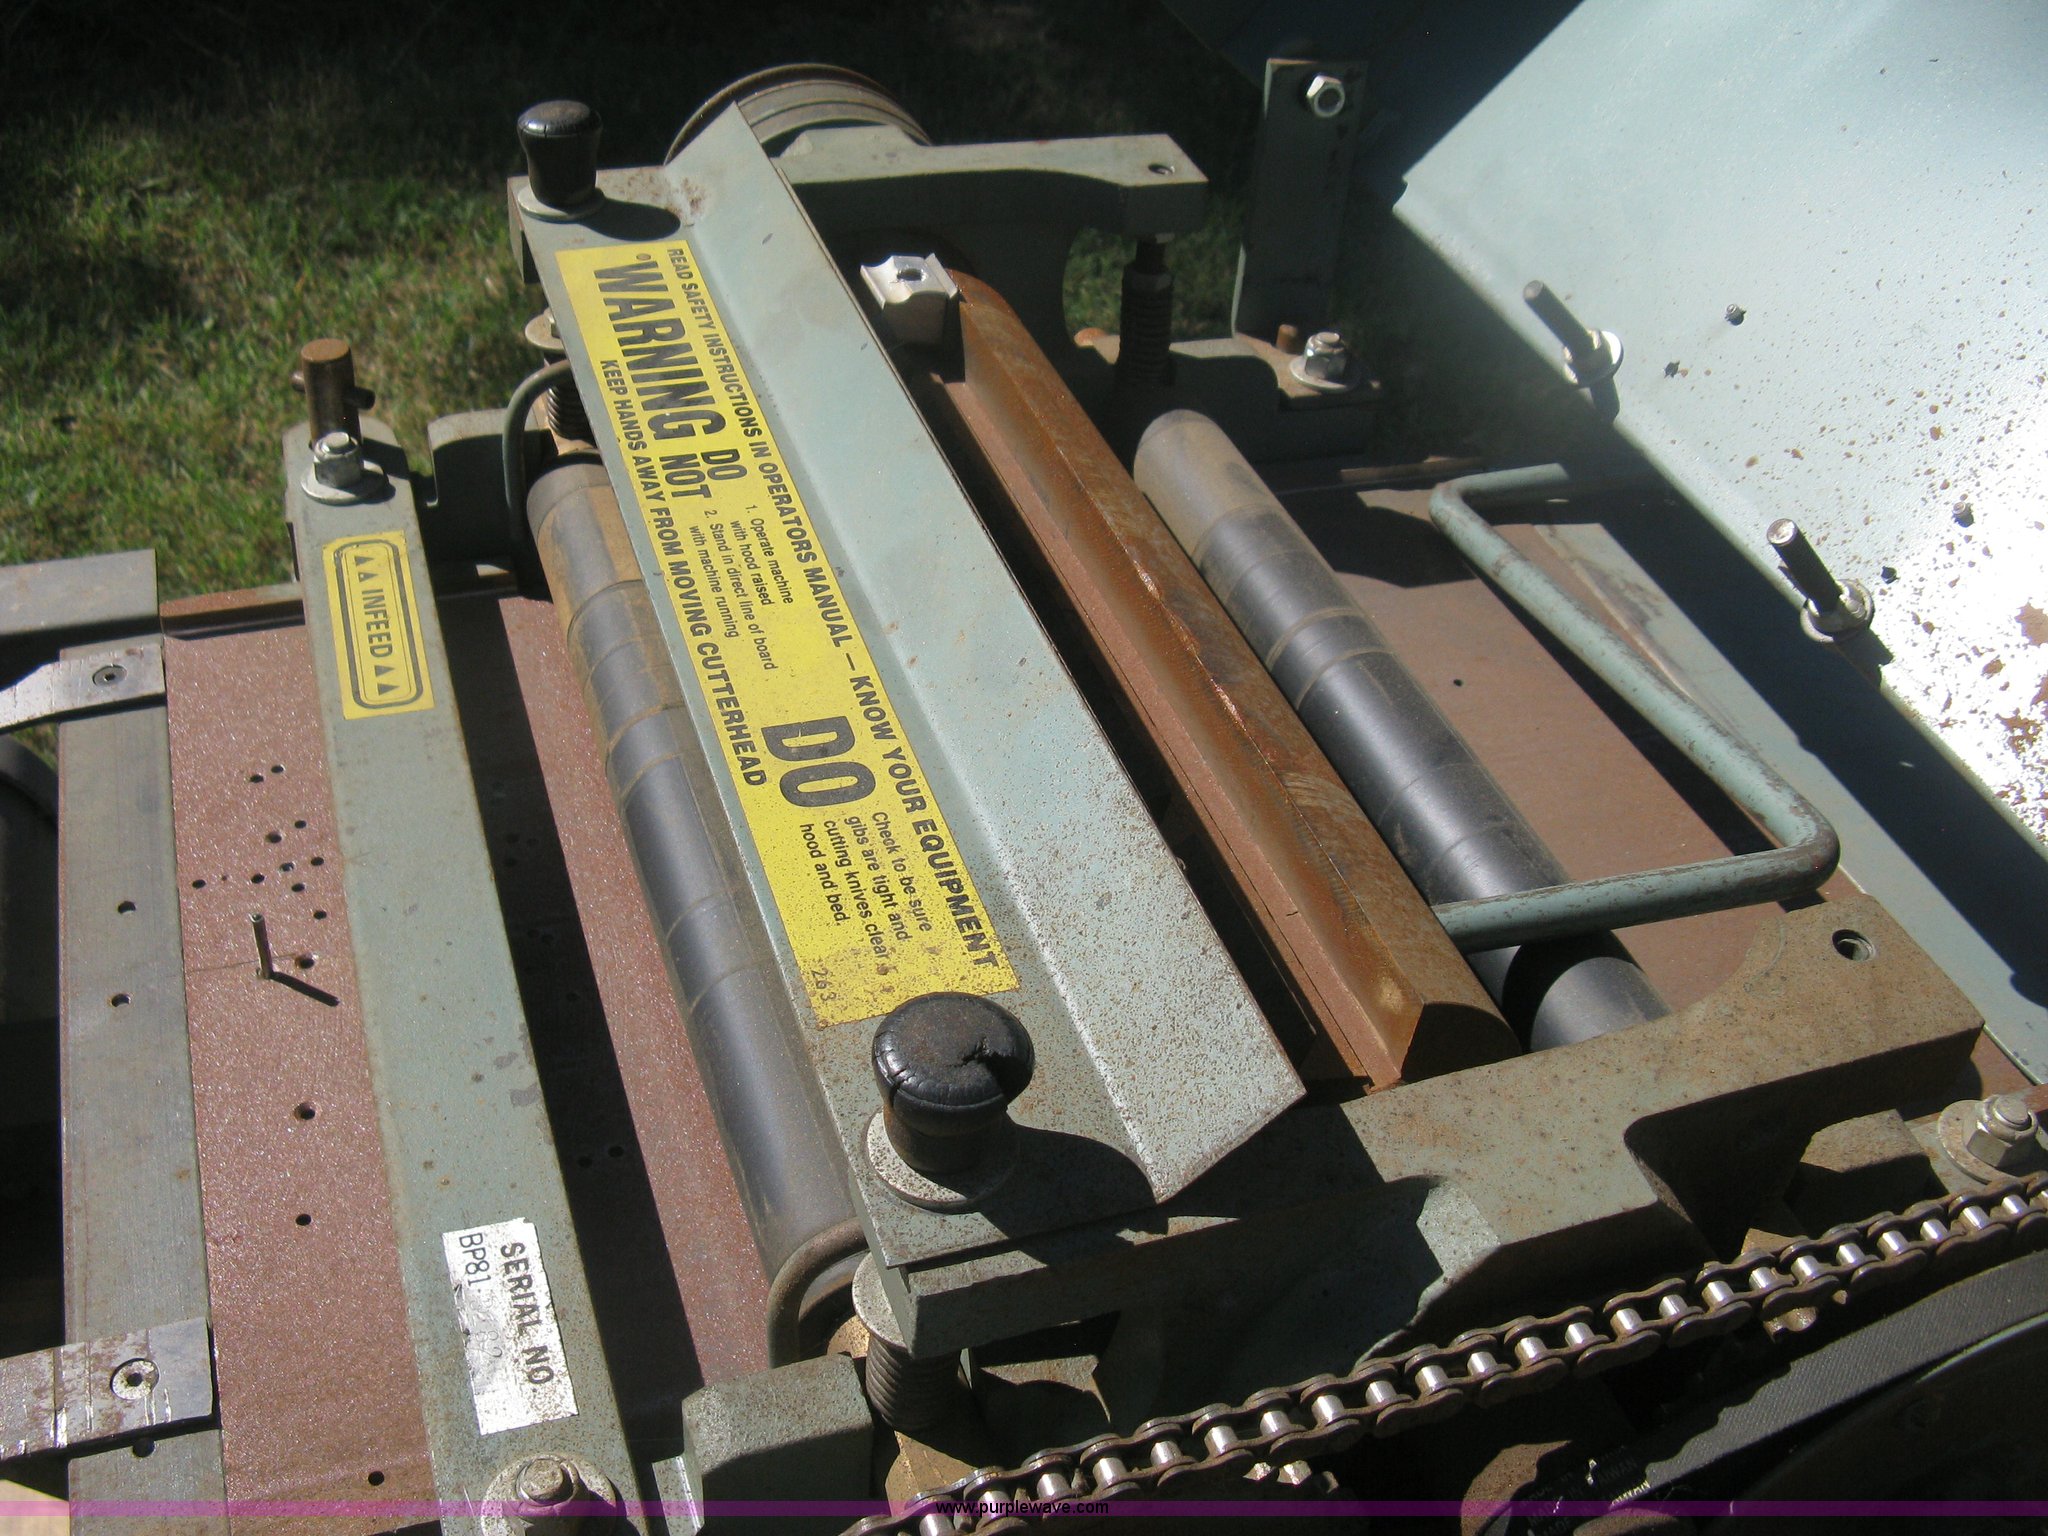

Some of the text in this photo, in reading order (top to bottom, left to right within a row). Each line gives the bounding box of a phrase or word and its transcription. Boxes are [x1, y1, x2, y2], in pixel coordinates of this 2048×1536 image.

[667, 248, 693, 280] READ
[681, 282, 716, 329] SAFETY
[594, 261, 726, 440] WARNING
[703, 333, 762, 437] INSTRUCTIONS
[659, 453, 712, 498] NOT
[701, 449, 747, 480] DO
[749, 442, 772, 458] IN
[710, 523, 732, 552] Stand
[759, 463, 817, 563] OPERATORS
[600, 360, 767, 786] KEEP HANDS AWAY FROM MOVING CUTTERHEAD
[689, 525, 740, 638] with machine running
[721, 555, 735, 565] in
[726, 567, 748, 598] direct
[730, 520, 775, 605] with hood raised
[751, 518, 774, 557] Operate
[768, 559, 794, 604] machine
[361, 588, 393, 658] INFEED
[739, 600, 755, 620] line
[748, 623, 765, 634] of
[803, 567, 853, 647] MANUAL
[754, 637, 779, 671] board
[850, 675, 899, 740] KNOW
[761, 715, 876, 807] DO
[883, 746, 927, 813] YOUR
[799, 823, 826, 858] hood
[814, 863, 838, 890] and
[823, 820, 891, 960] cutting knives clear
[844, 816, 913, 942] gibs are tight and
[872, 811, 932, 932] Check to be sure
[912, 819, 1000, 968] EQUIPMENT
[500, 1242, 542, 1337] SERIAL
